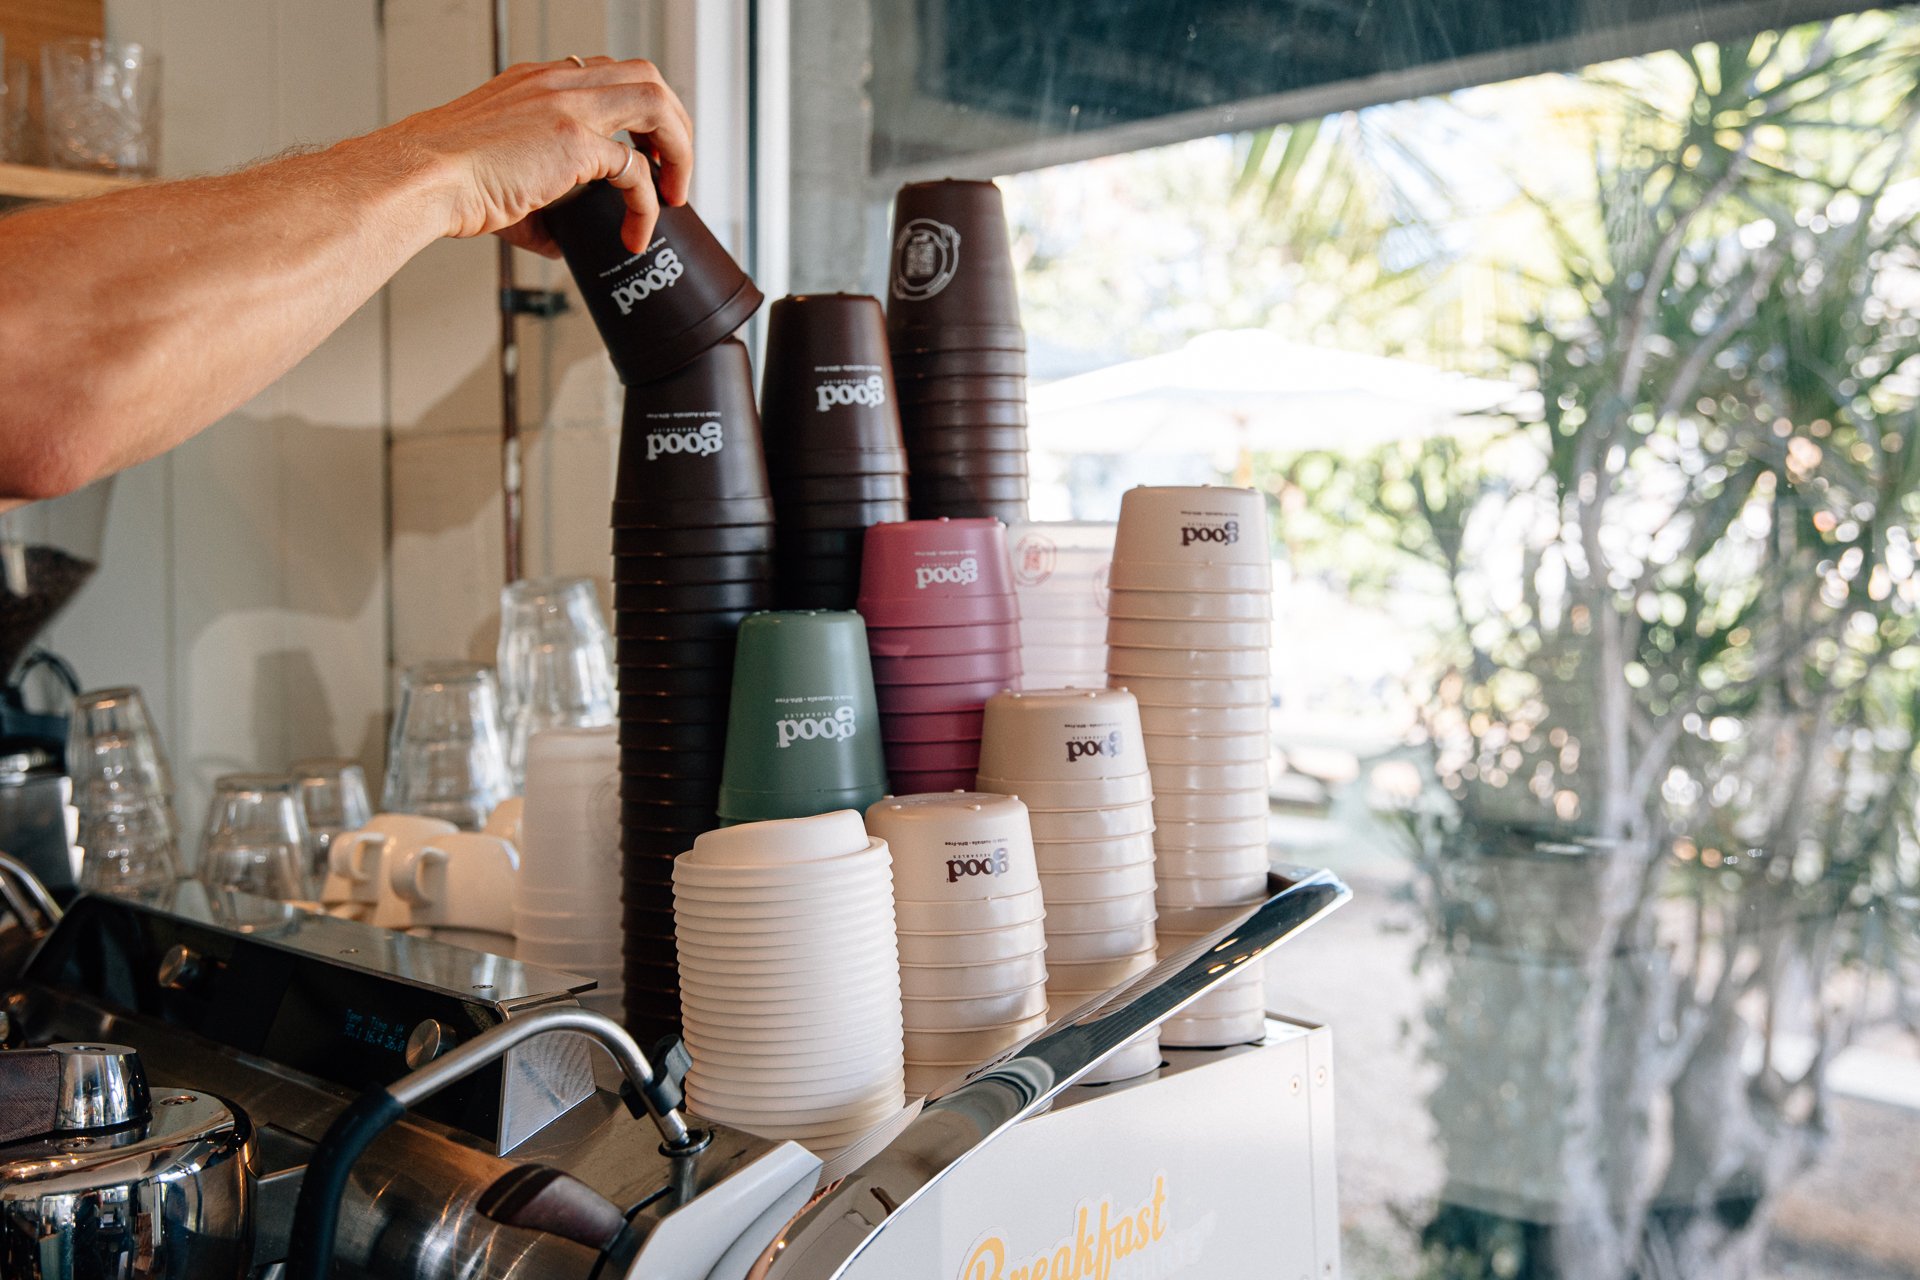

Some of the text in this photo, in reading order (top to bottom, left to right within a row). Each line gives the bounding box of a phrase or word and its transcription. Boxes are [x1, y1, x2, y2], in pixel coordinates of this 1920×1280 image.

[611, 248, 684, 315] good
[816, 374, 885, 412] good
[645, 421, 723, 461] good
[1181, 521, 1239, 546] good
[915, 557, 978, 589] good
[776, 705, 856, 748] good
[1065, 730, 1123, 763] good
[946, 847, 1009, 883] good
